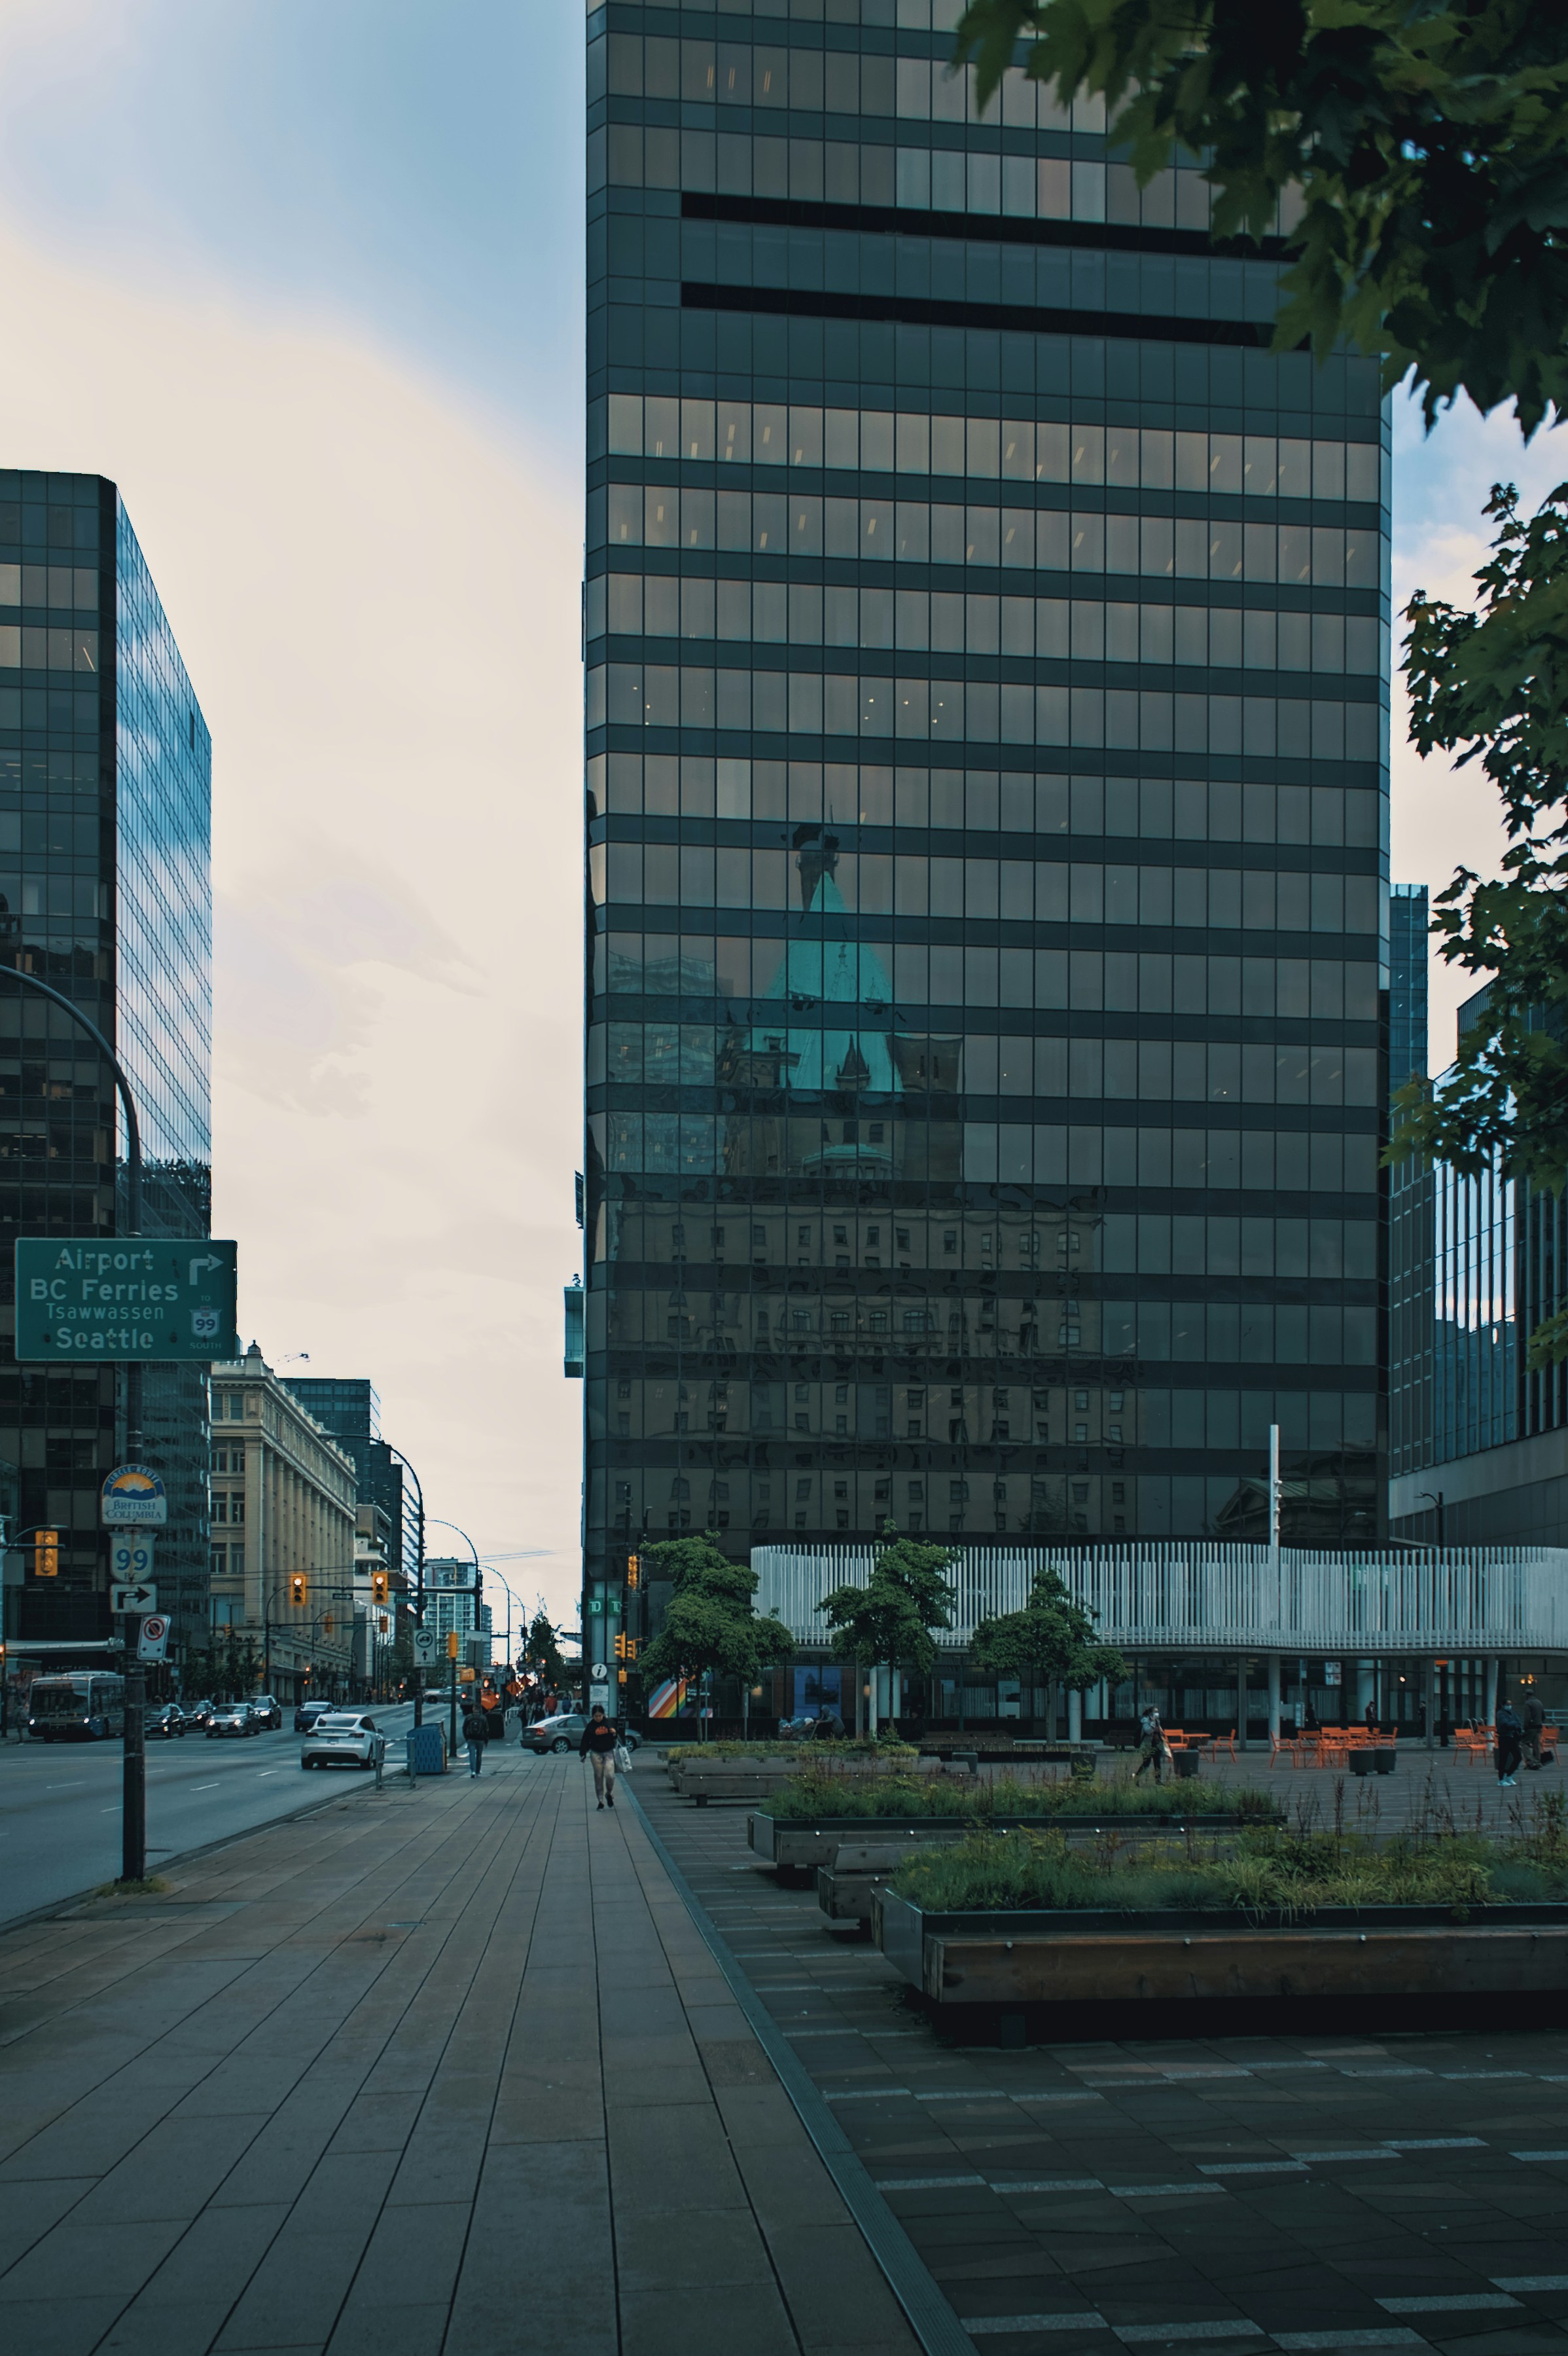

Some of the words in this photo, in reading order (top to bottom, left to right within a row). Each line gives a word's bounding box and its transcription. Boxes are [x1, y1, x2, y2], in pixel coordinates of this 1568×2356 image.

[55, 1248, 154, 1275] Airport
[30, 1278, 67, 1301] BC
[82, 1279, 179, 1301] Ferries
[46, 1303, 164, 1320] Tsawwassen
[195, 1319, 216, 1331] 99
[56, 1327, 154, 1349] Seattle
[107, 1466, 132, 1485] CIRCLE
[135, 1466, 160, 1483] ROUTE
[113, 1500, 156, 1510] BRITISH
[106, 1510, 162, 1519] COLUMBIA
[116, 1549, 148, 1571] 99
[590, 1601, 601, 1612] TD
